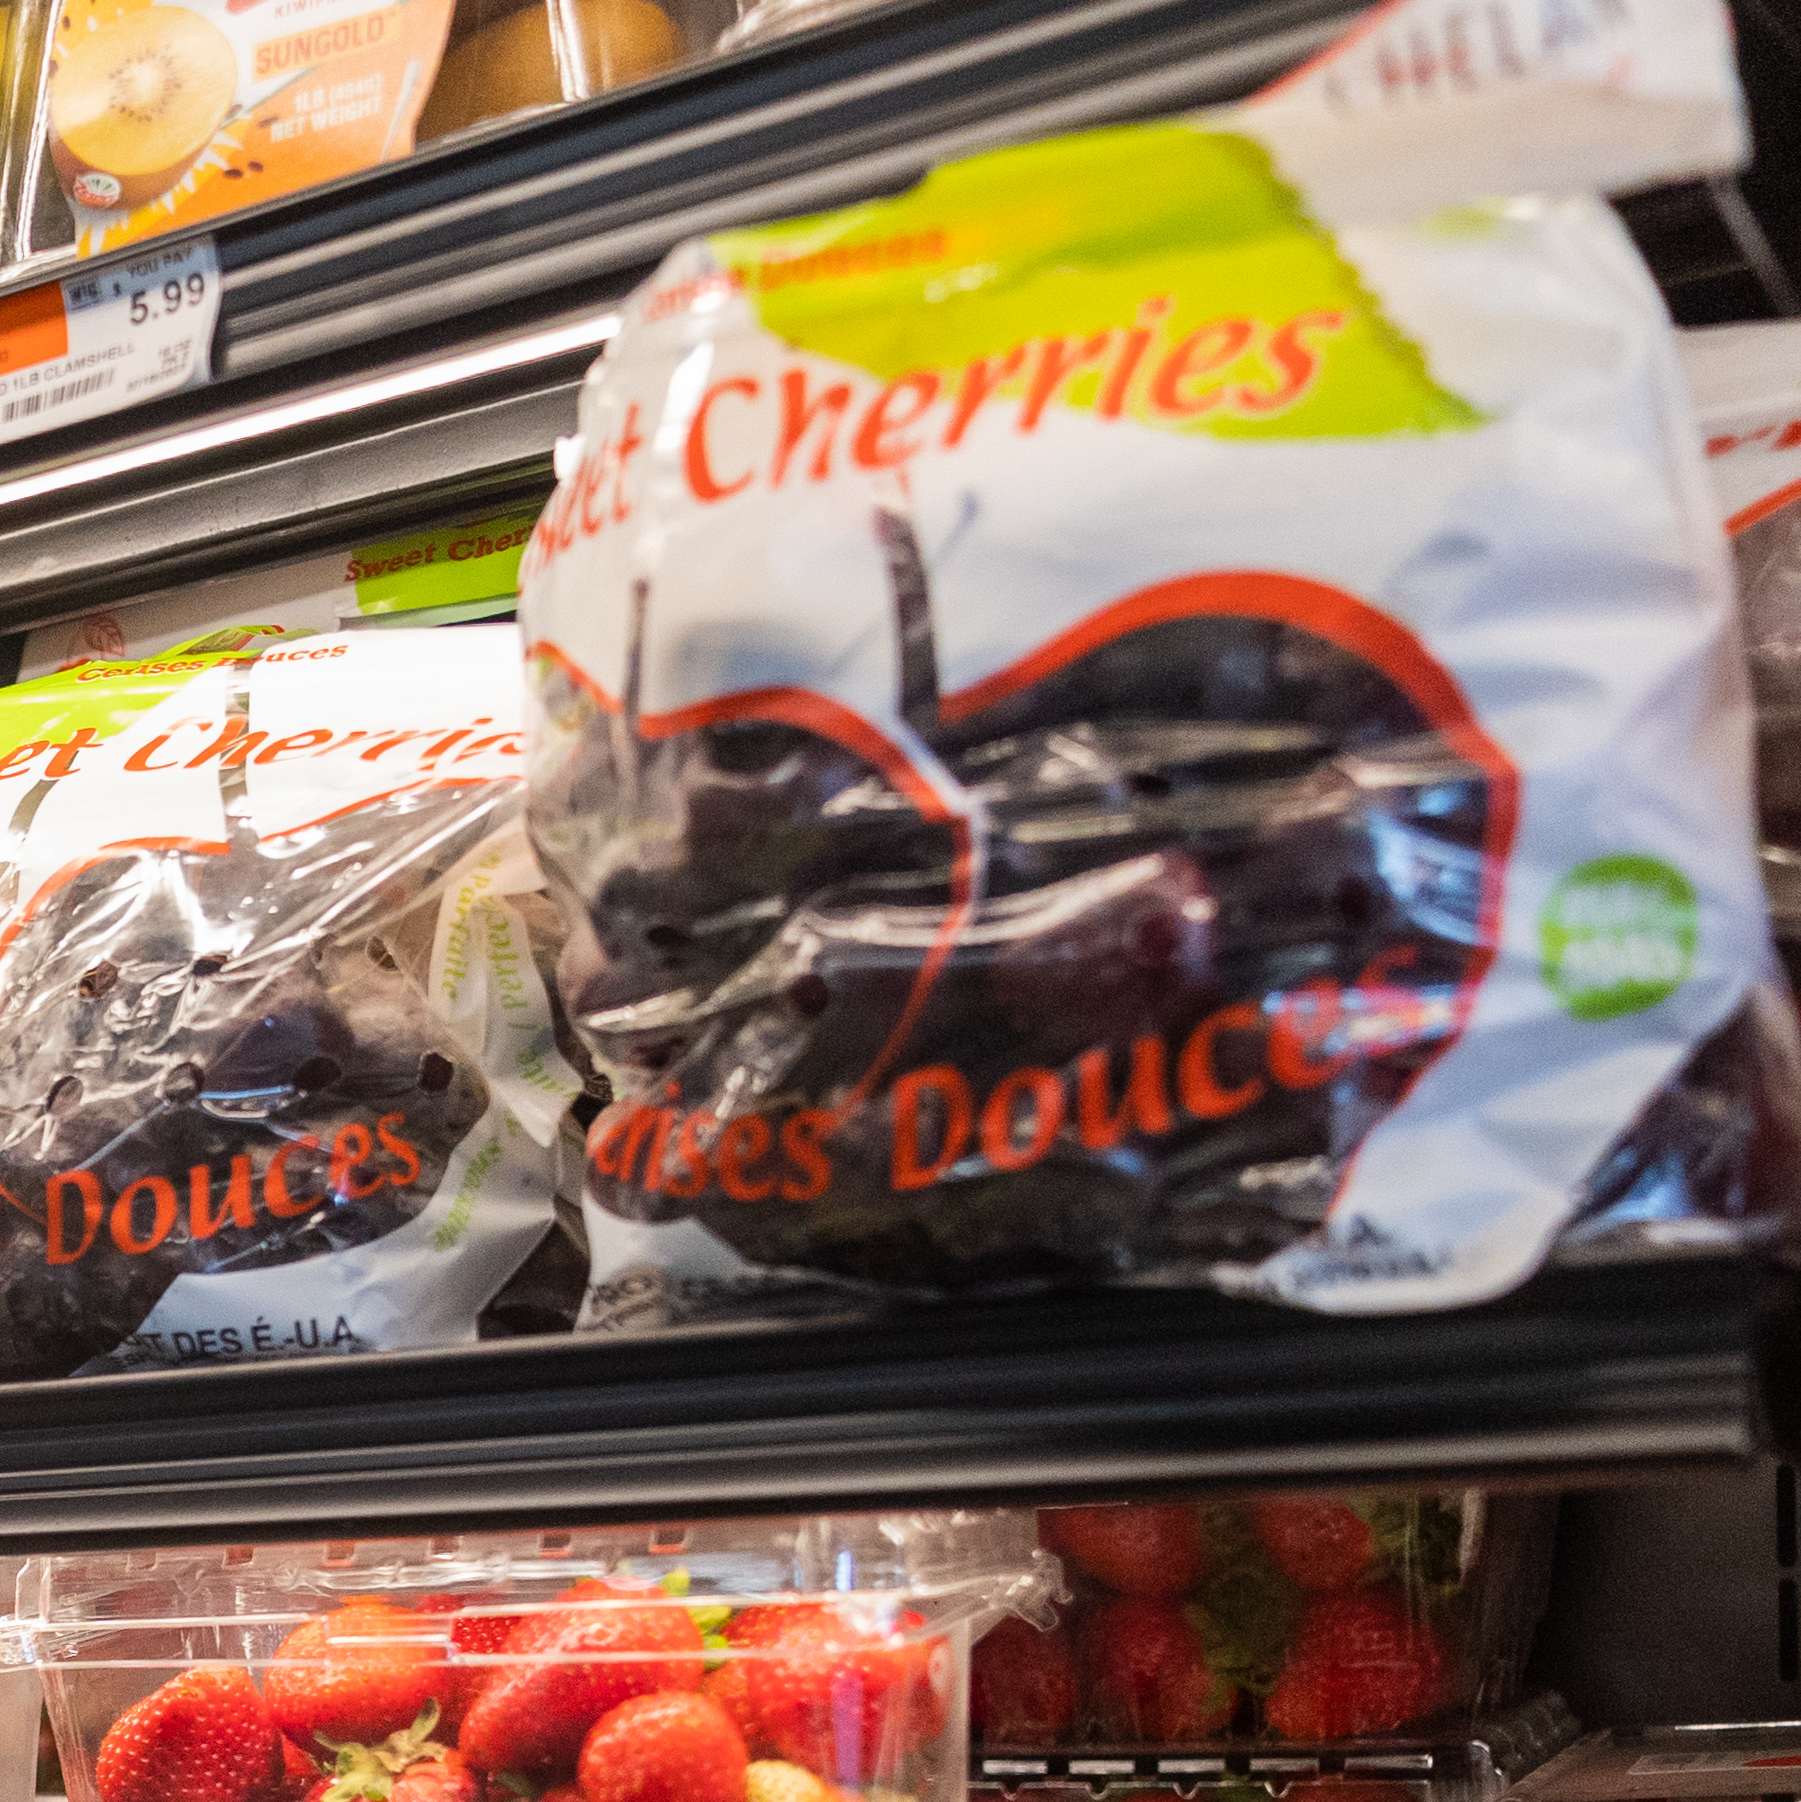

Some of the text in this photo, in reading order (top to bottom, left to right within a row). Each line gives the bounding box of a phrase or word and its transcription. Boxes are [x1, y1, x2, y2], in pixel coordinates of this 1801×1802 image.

[256, 15, 386, 76] SUNGOLD
[270, 96, 384, 143] NET WEIGHT
[129, 272, 206, 325] 5.99
[12, 372, 40, 394] 1LB
[43, 340, 136, 381] CLAMSHELL
[683, 293, 1348, 506] Cherries
[343, 543, 437, 584] Sweet
[890, 943, 1421, 1194] Douces
[45, 1112, 423, 1266] Douces
[171, 1327, 245, 1358] DES
